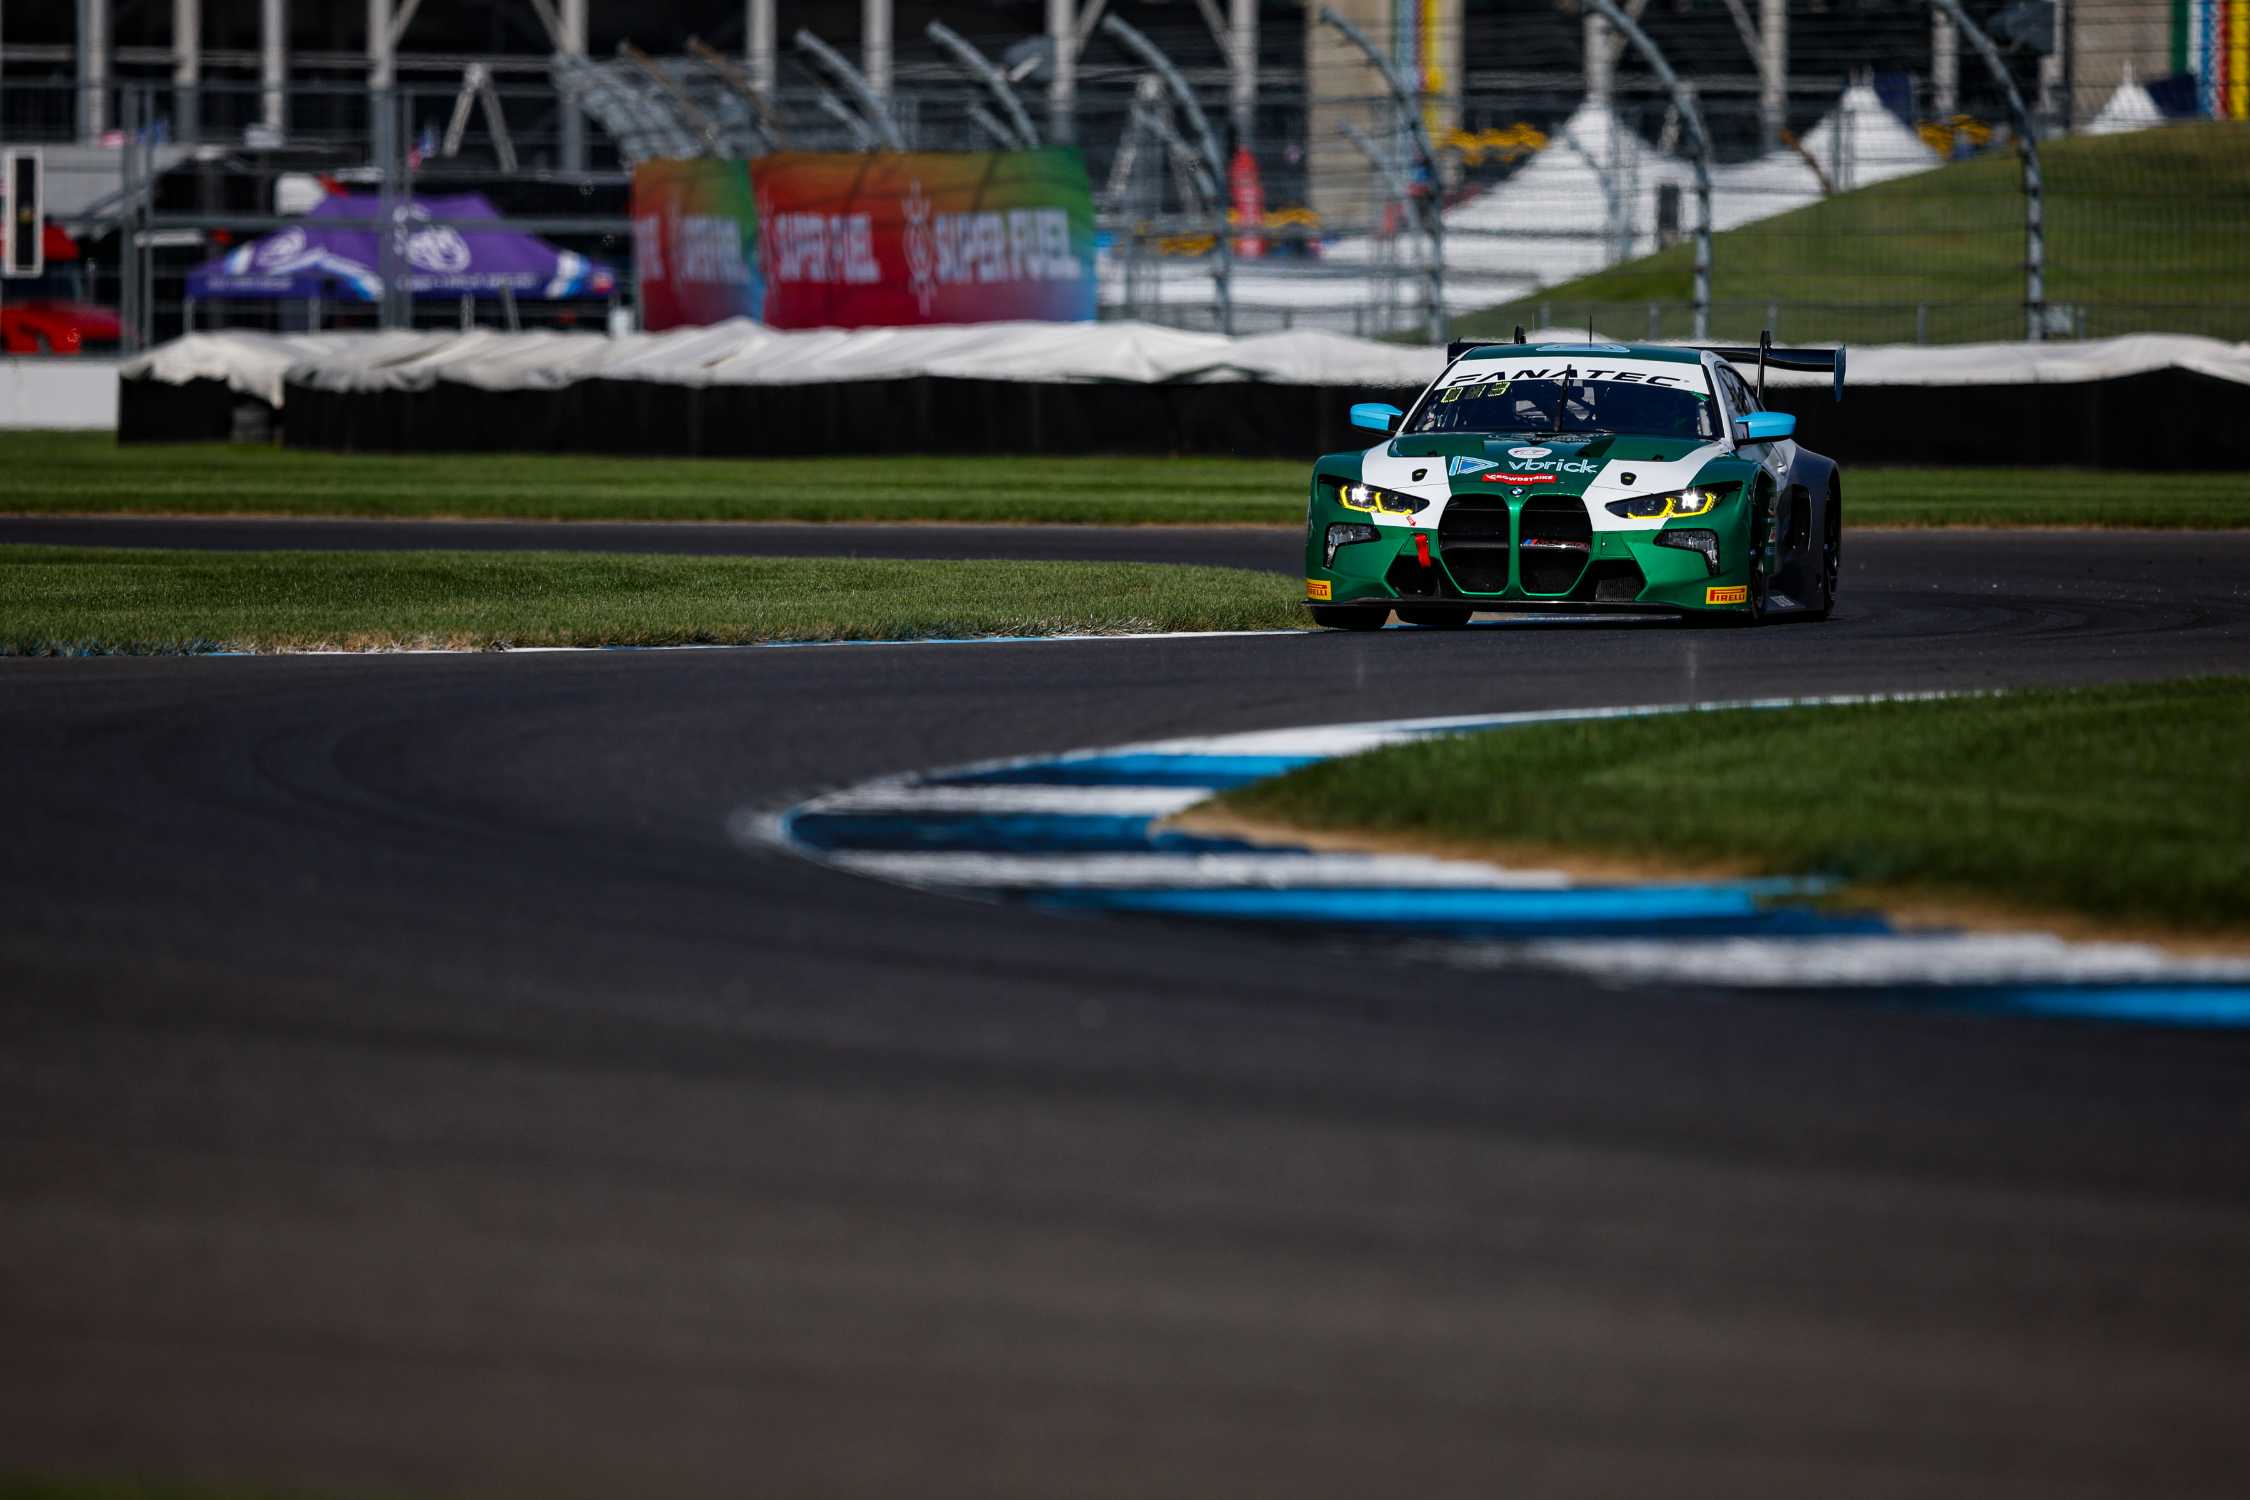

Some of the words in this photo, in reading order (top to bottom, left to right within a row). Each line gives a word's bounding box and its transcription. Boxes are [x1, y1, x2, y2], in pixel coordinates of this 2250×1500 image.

[1449, 368, 1683, 387] FANATEC
[1508, 459, 1599, 473] vbrick
[1709, 588, 1746, 602] PIRELLI
